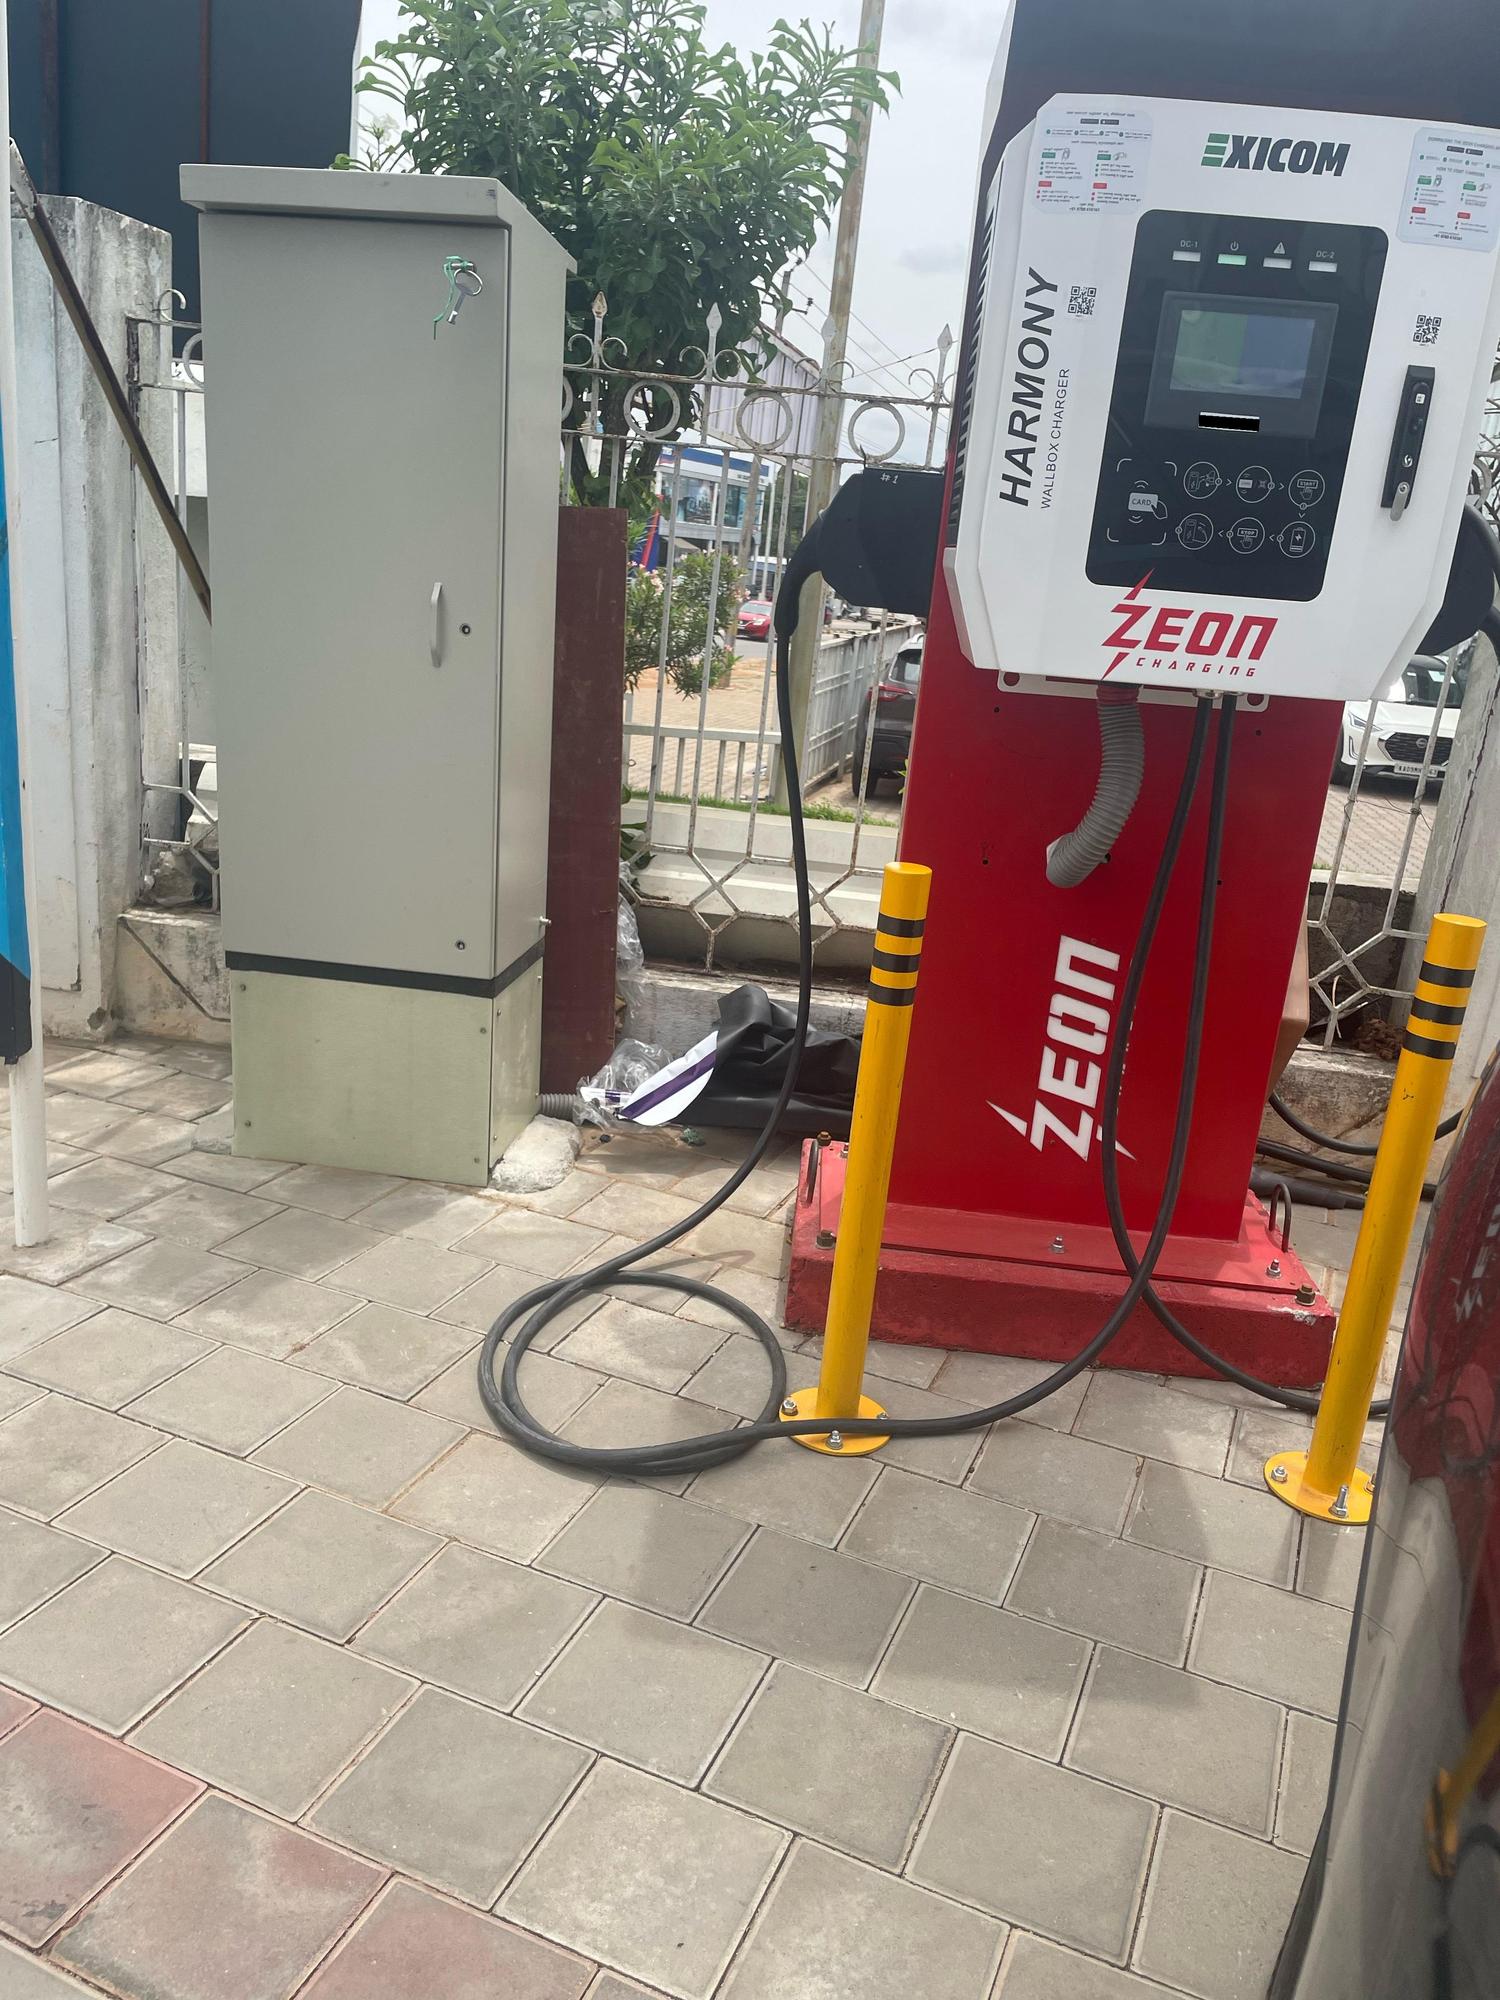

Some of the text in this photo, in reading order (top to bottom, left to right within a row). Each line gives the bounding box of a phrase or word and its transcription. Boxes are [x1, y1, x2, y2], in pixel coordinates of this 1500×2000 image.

[1201, 133, 1351, 176] EXICOM
[1180, 240, 1198, 248] DC-1
[1316, 251, 1335, 259] DC-2
[999, 266, 1058, 507] HARMONY
[1040, 368, 1070, 509] WALLBOX CHARGER
[1102, 603, 1278, 660] ZEON
[1136, 657, 1256, 677] CHARGING
[1030, 935, 1120, 1161] ZEON
